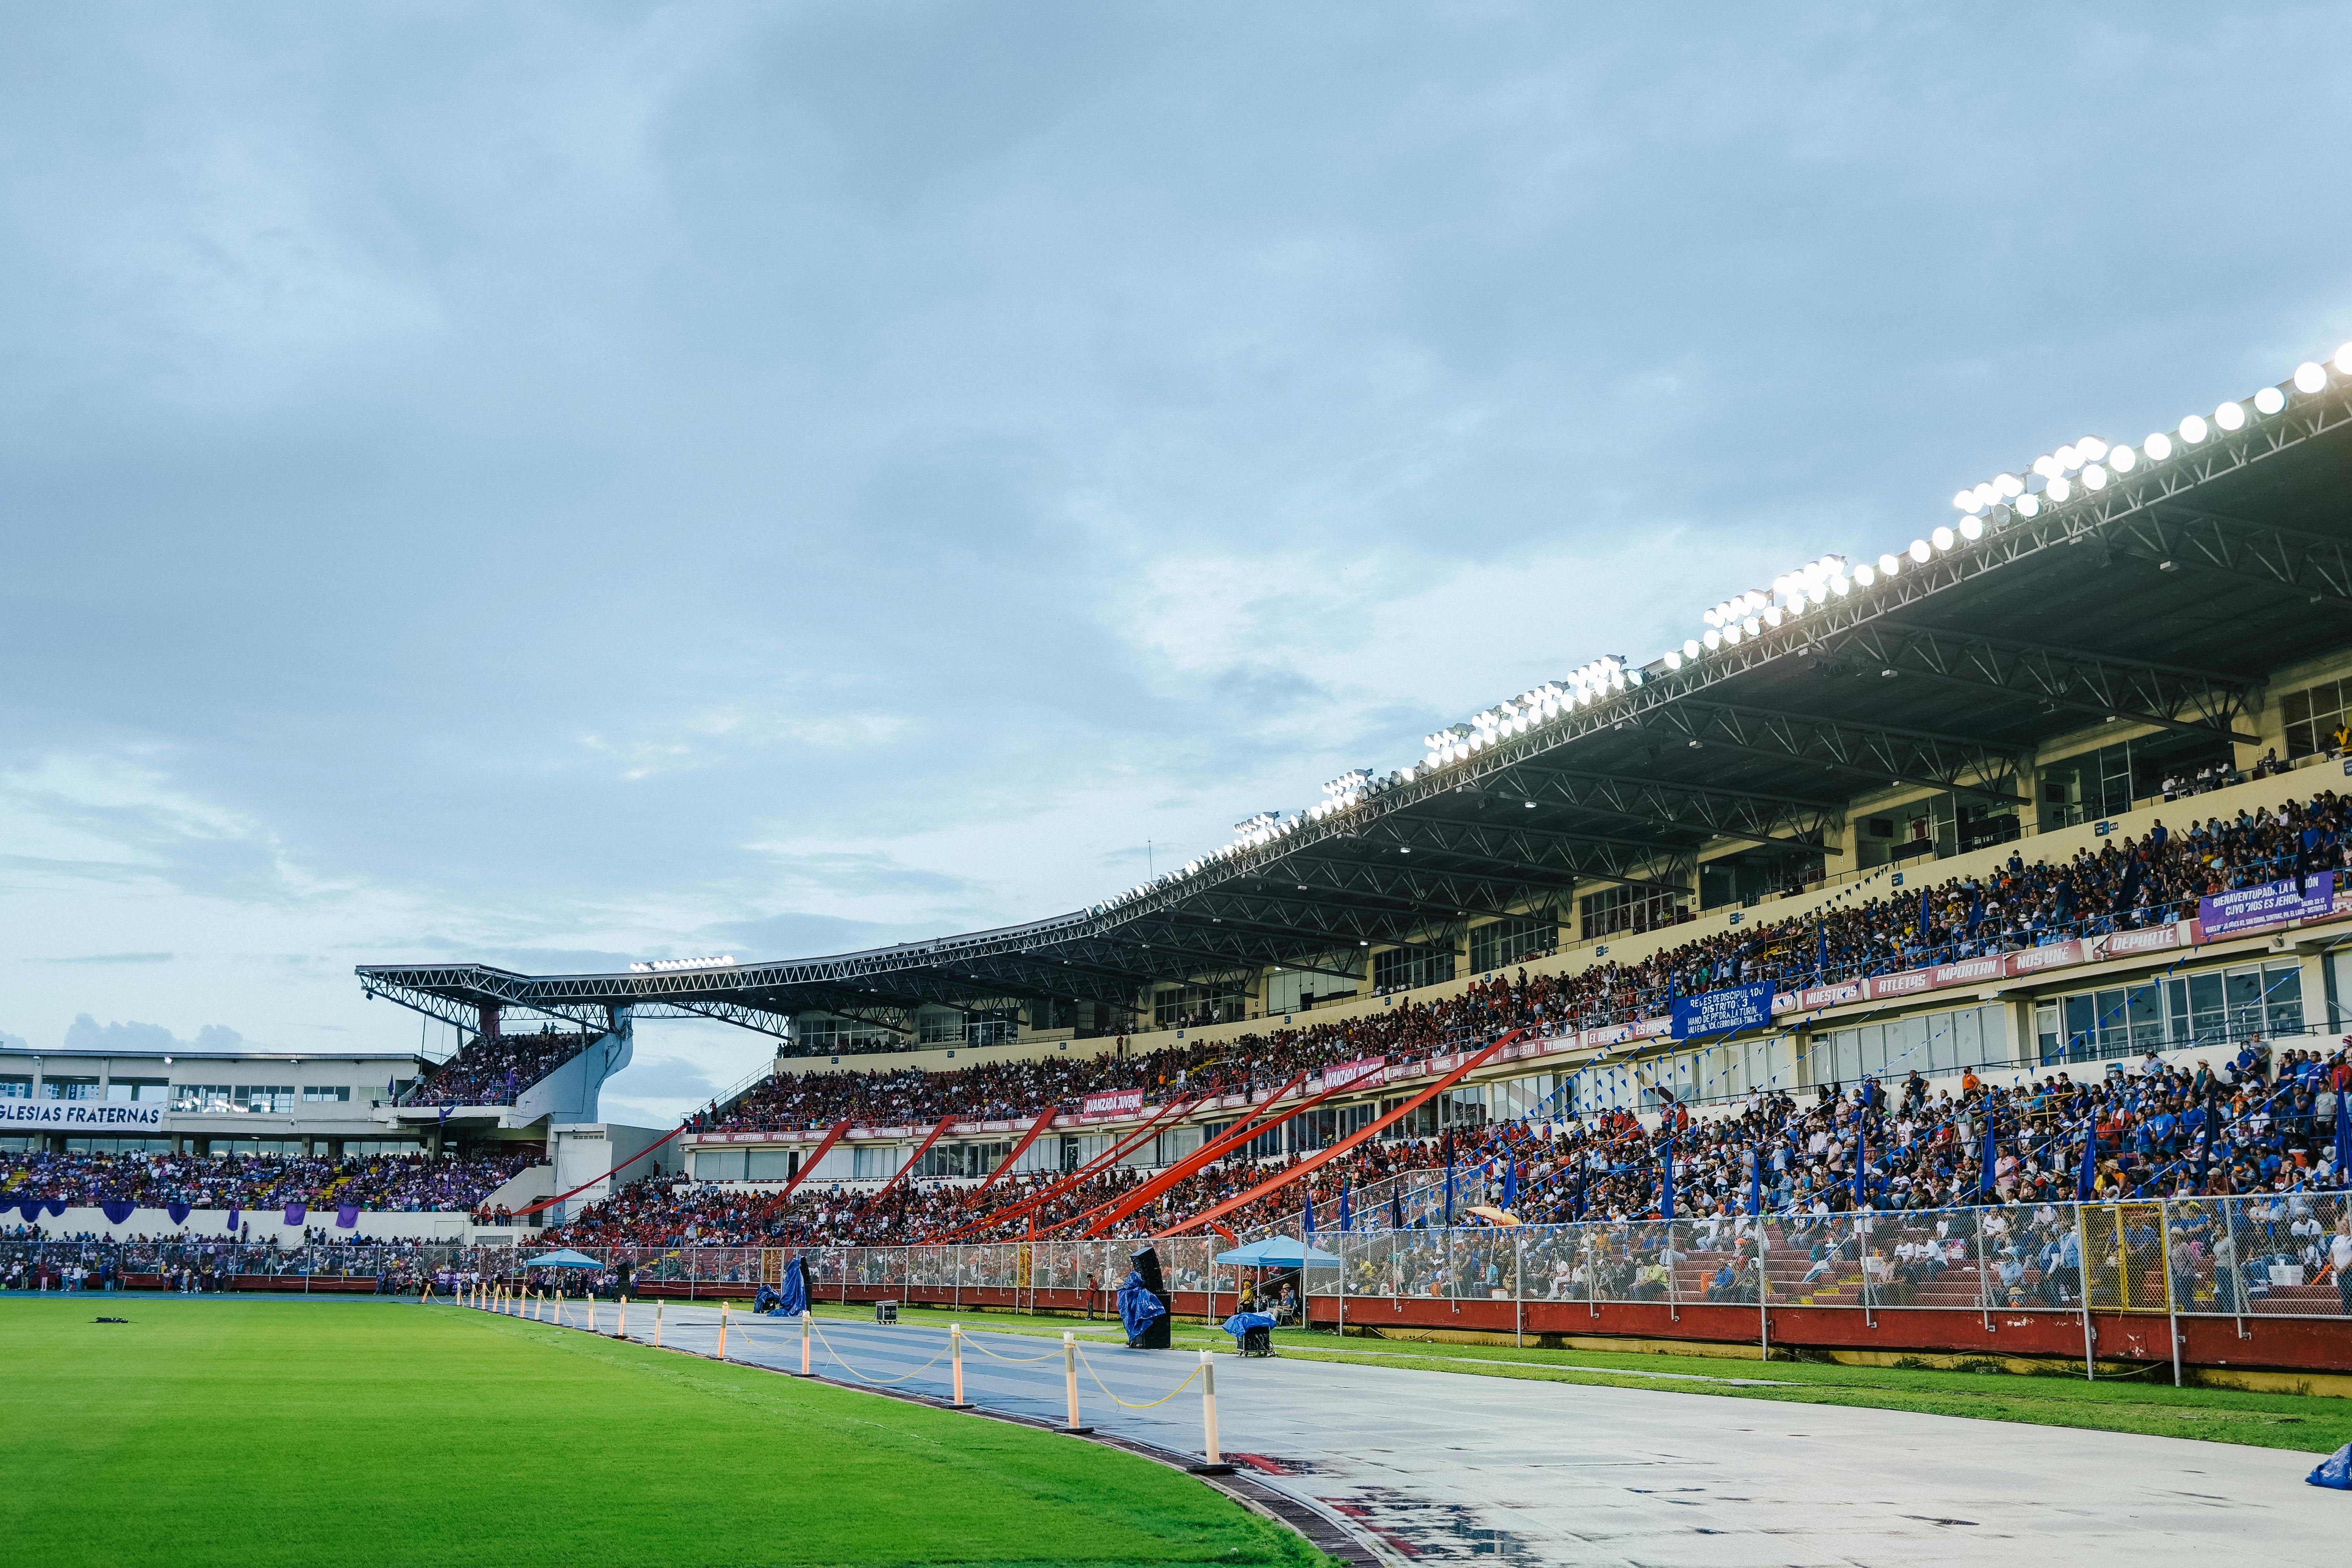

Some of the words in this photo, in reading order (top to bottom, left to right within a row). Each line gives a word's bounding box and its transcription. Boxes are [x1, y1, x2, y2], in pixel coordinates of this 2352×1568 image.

[2279, 883, 2288, 894] LA
[2290, 876, 2319, 892] NIÓN
[2225, 903, 2244, 916] CUYO
[2264, 898, 2274, 909] ES
[2307, 905, 2324, 914] DISTRITO
[2112, 928, 2175, 951] DEPORTE
[2017, 953, 2043, 969] NOS
[2044, 946, 2069, 964] UNE
[1936, 960, 1997, 982] IMPORTAN
[1879, 974, 1926, 993] ATLETAS
[1713, 994, 1721, 1003] DE
[1771, 995, 1794, 1009] ORIA
[1806, 985, 1857, 1005] NUESTROS
[1702, 1000, 1736, 1014] DISTRITO
[1742, 998, 1748, 1007] 3
[1688, 1015, 1702, 1025] MANO
[1703, 1013, 1710, 1023] DE
[1717, 1020, 1730, 1028] CERRO
[1589, 1033, 1597, 1044] EL
[1597, 1029, 1630, 1042] DEPORTE
[1635, 1024, 1646, 1035] ES
[1543, 1040, 1552, 1051] TU
[1552, 1036, 1576, 1049] BARRA
[1390, 1064, 1420, 1078] CAMPEONES
[1432, 1058, 1451, 1071] VAMOS
[1305, 1084, 1315, 1093] NOS
[1084, 1096, 1117, 1112] AVANZADA
[1117, 1094, 1141, 1111] JUVENIL
[1223, 1096, 1245, 1107] NUESTROS
[1252, 1092, 1268, 1102] TLETAS
[67, 1107, 159, 1124] FRATERNAS
[1021, 1120, 1038, 1129] BARR
[881, 1129, 907, 1137] DEPORTE
